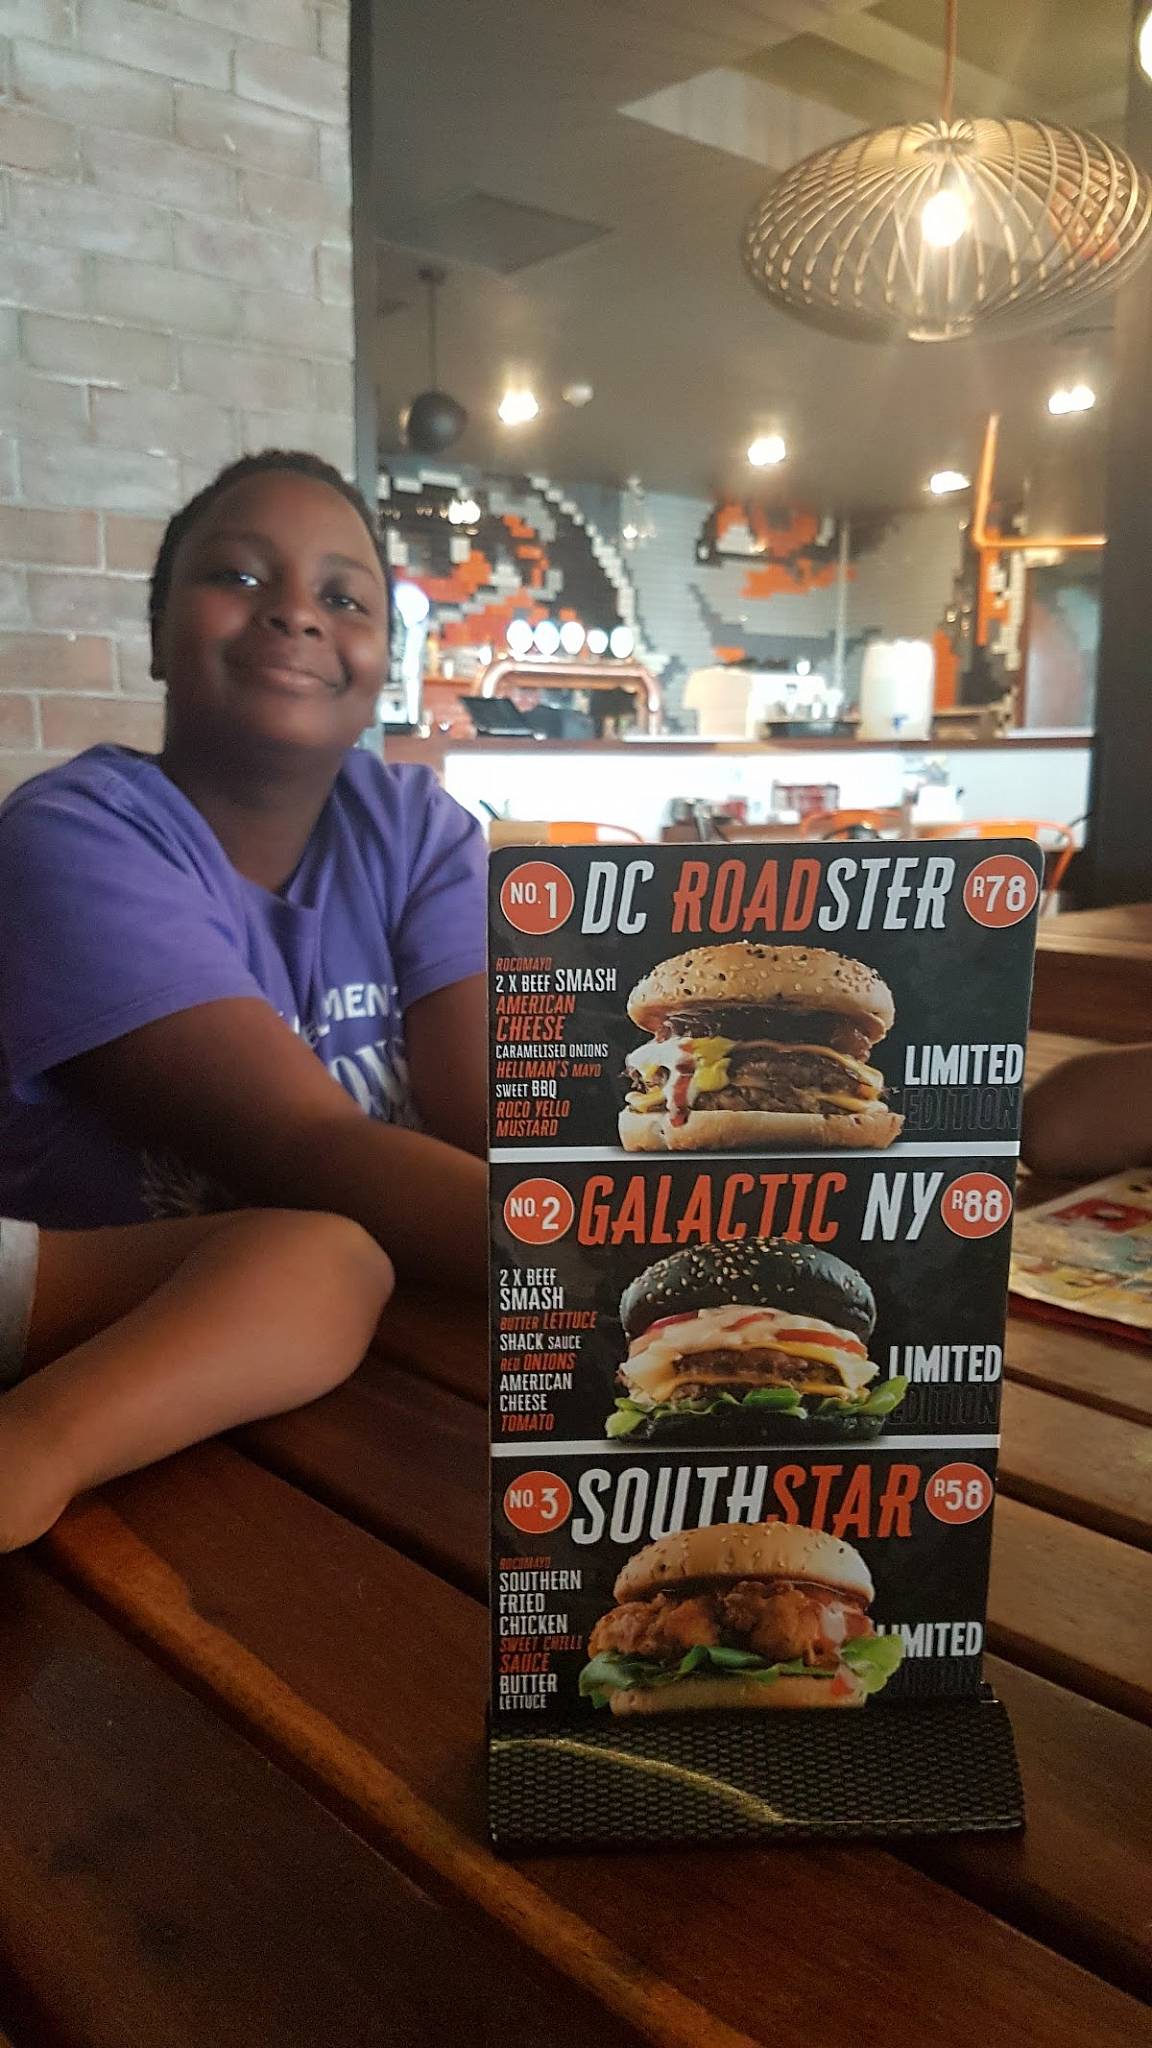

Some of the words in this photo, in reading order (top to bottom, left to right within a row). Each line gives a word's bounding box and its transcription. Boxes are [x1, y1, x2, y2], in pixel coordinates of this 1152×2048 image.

[581, 860, 655, 935] DC
[672, 857, 956, 934] ROADSTER
[972, 875, 1027, 913] R78
[496, 957, 552, 972] ROCOMAYO
[496, 975, 505, 993] 2
[509, 974, 518, 993] X
[521, 974, 551, 993] BEEF
[555, 968, 617, 992] SMASH
[496, 994, 576, 1015] AMERICAN
[496, 1015, 565, 1042] CHEESE
[496, 1044, 566, 1059] CARAMELISED
[569, 1043, 608, 1058] ONIONS
[496, 1061, 568, 1078] HELLMAN'S
[572, 1063, 602, 1078] MAYO
[904, 1044, 1024, 1086] LIMITED
[496, 1083, 528, 1098] SWEET
[531, 1080, 557, 1099] BBQ
[496, 1100, 530, 1118] ROCO
[535, 1100, 570, 1117] YELLO
[903, 1087, 1022, 1131] EDITION
[496, 1118, 558, 1137] MUSTARD
[577, 1172, 847, 1245] GALACTIC
[860, 1172, 944, 1241] NY
[952, 1189, 1003, 1223] R88
[500, 1269, 508, 1286] 2
[513, 1269, 523, 1286] X
[527, 1268, 557, 1286] BEEF
[500, 1287, 564, 1311] SMASH
[500, 1315, 539, 1331] BUTTER
[543, 1311, 598, 1330] LETTUCE
[500, 1333, 544, 1351] SHACK
[548, 1335, 581, 1350] SAUCE
[500, 1358, 520, 1372] RED
[523, 1353, 577, 1371] ONIONS
[889, 1345, 1002, 1383] LIMITED
[500, 1373, 573, 1391] AMERICAN
[500, 1394, 547, 1412] CHEESE
[501, 1413, 555, 1432] TOMATO
[934, 1478, 984, 1511] R58
[500, 1570, 582, 1592] SOUTHERN
[500, 1592, 545, 1614] FRIED
[500, 1614, 568, 1636] CHICKEN
[500, 1637, 539, 1651] SWEET
[499, 1653, 550, 1673] SAUCE
[500, 1674, 557, 1694] BUTTER
[500, 1694, 547, 1711] LETTUCE
